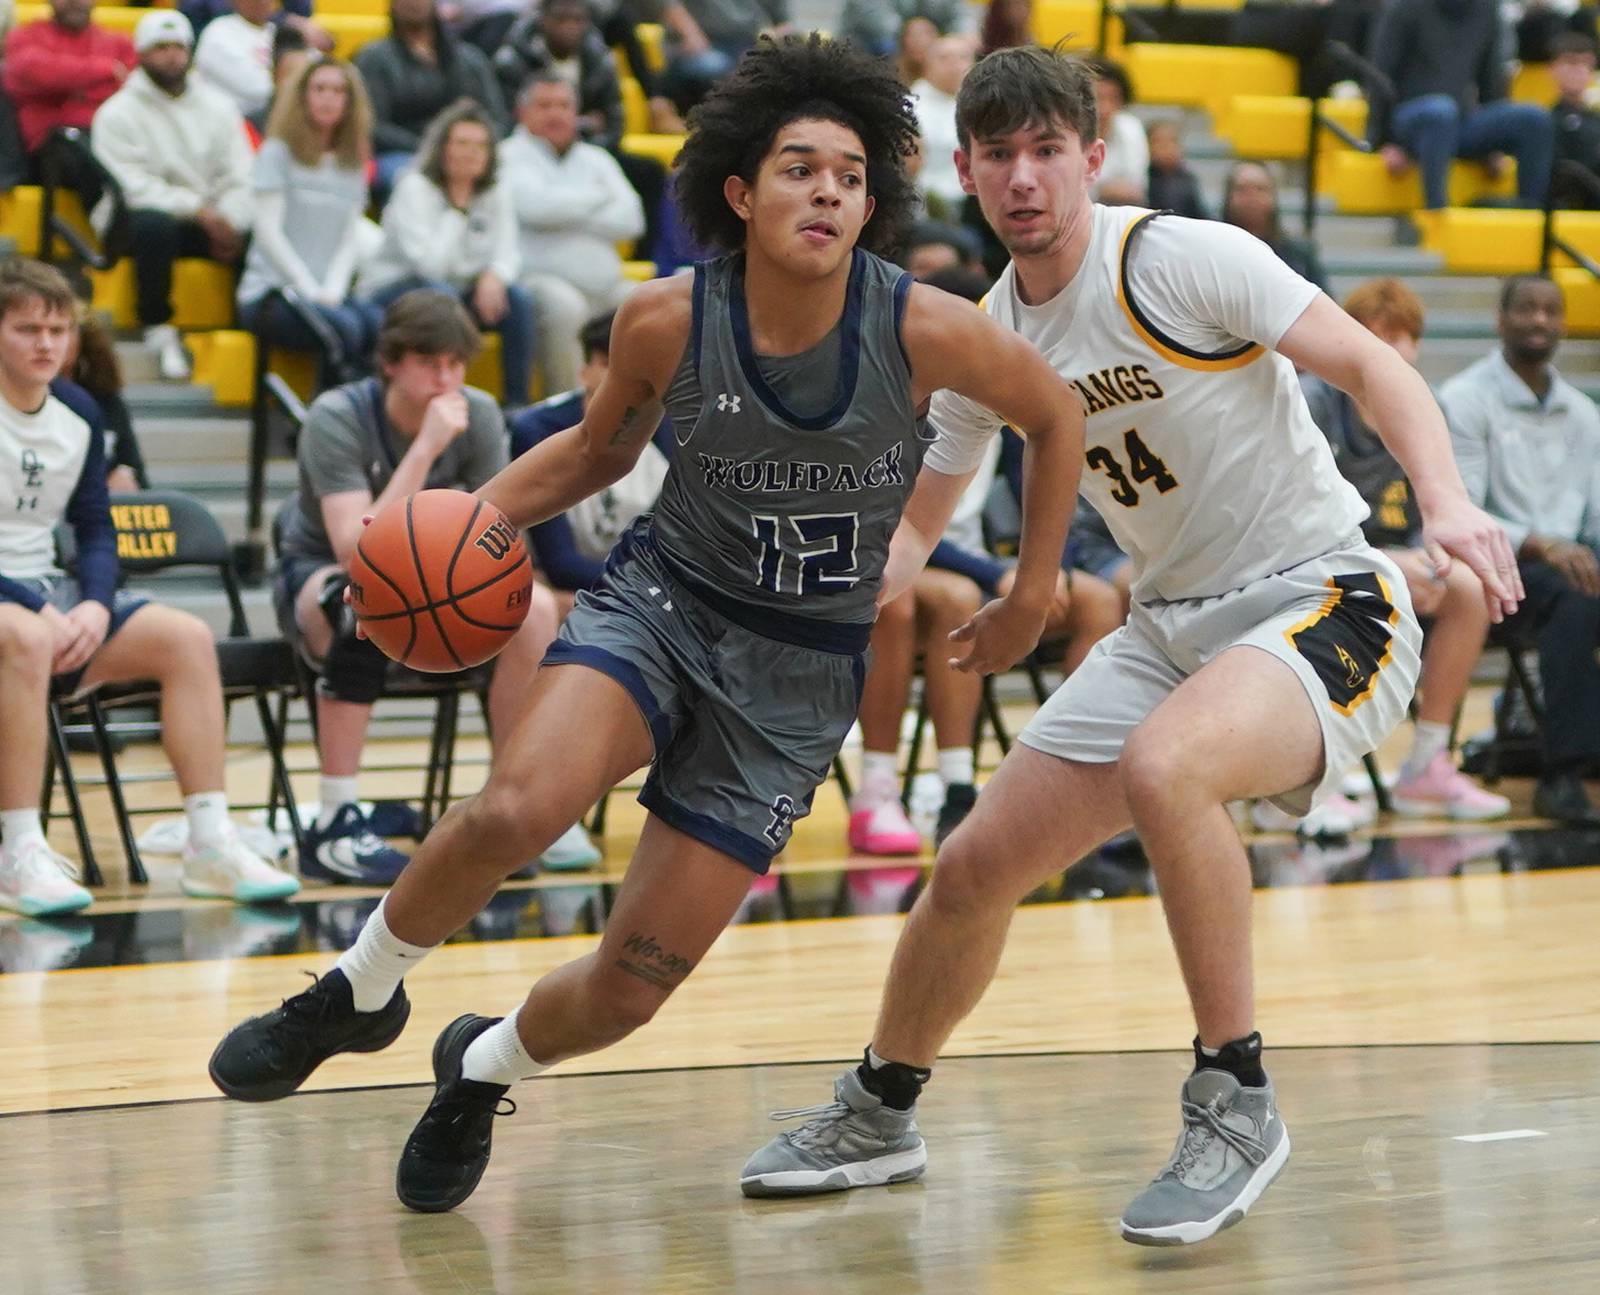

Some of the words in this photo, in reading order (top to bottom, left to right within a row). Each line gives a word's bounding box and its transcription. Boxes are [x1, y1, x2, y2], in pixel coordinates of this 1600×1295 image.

[1068, 364, 1164, 417] ANGS
[698, 440, 904, 493] WOLFPACK
[1085, 428, 1179, 508] 34
[116, 531, 177, 559] ALLEY
[751, 511, 860, 596] 12
